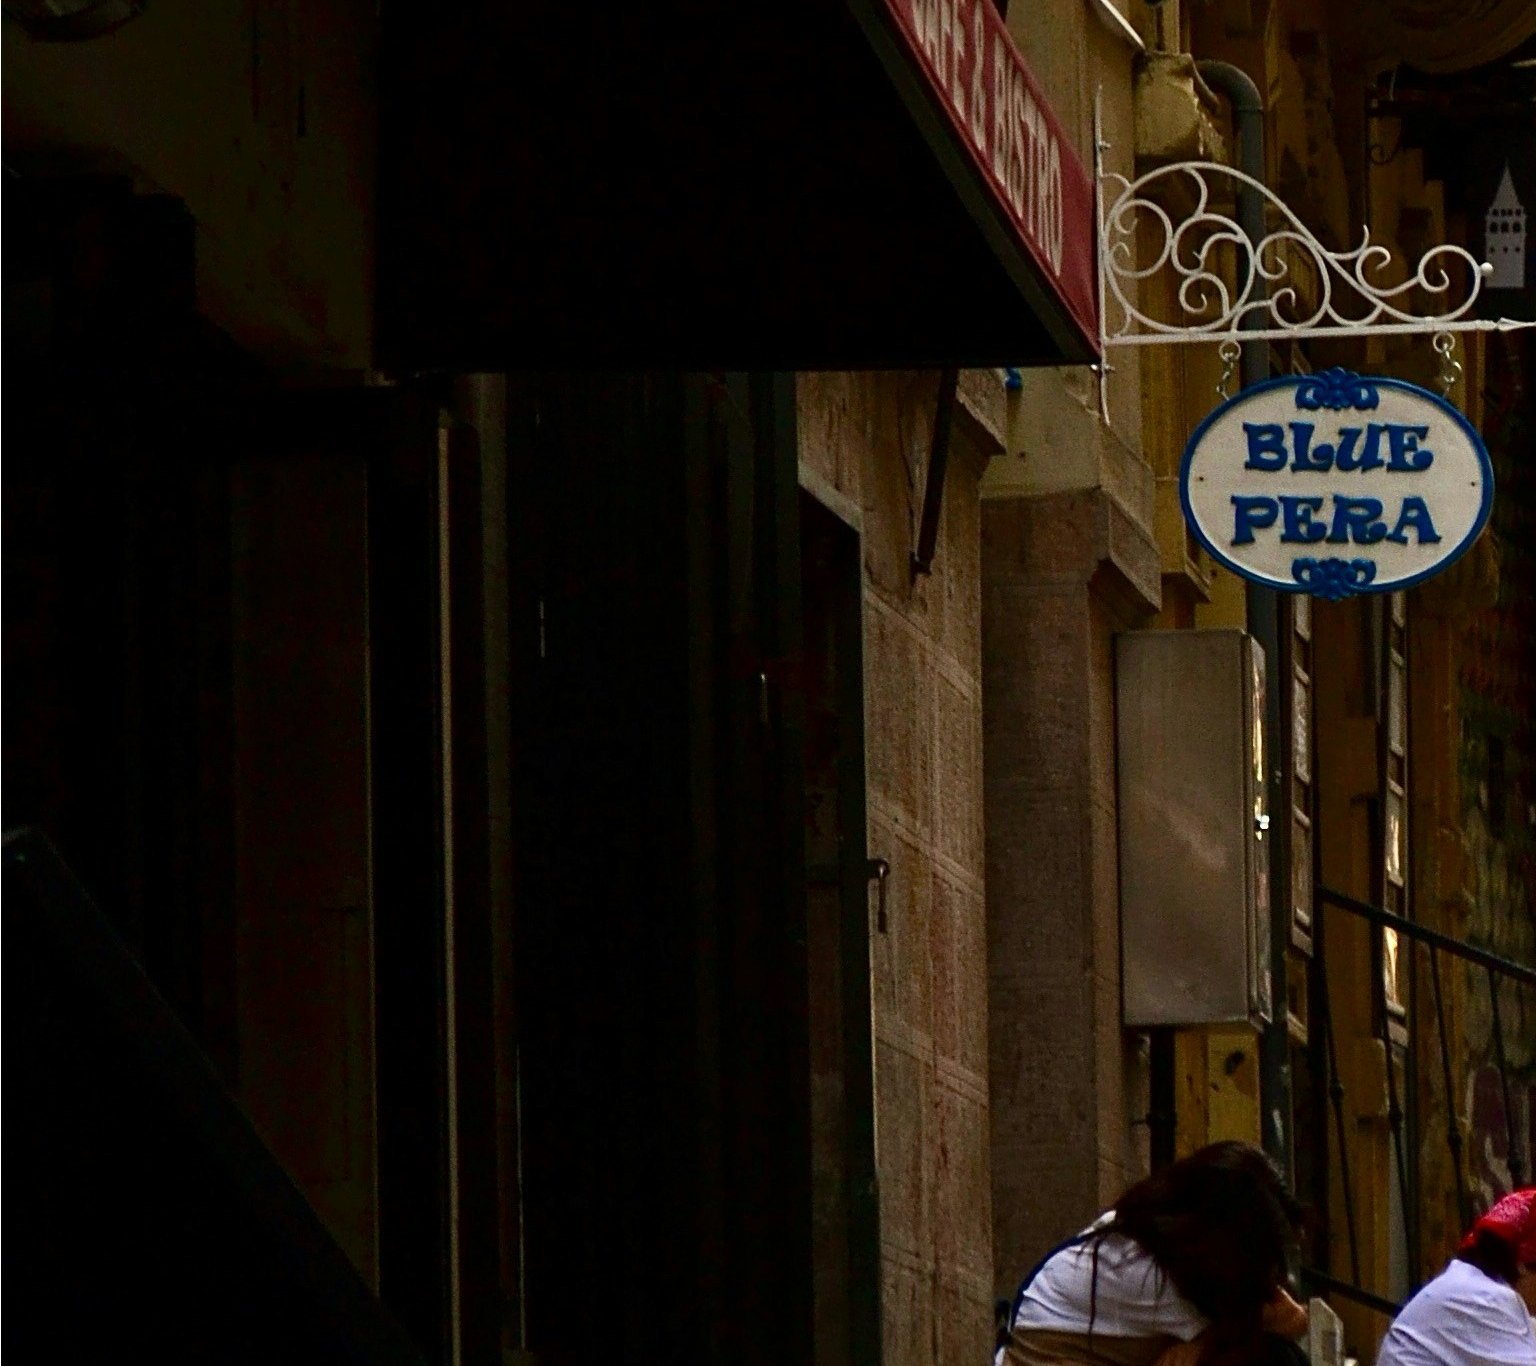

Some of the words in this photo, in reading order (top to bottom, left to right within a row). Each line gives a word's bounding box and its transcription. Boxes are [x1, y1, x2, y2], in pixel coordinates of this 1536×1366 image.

[993, 31, 1063, 279] BISTRO
[1242, 421, 1434, 473] BLUE
[1230, 494, 1442, 546] PERA
